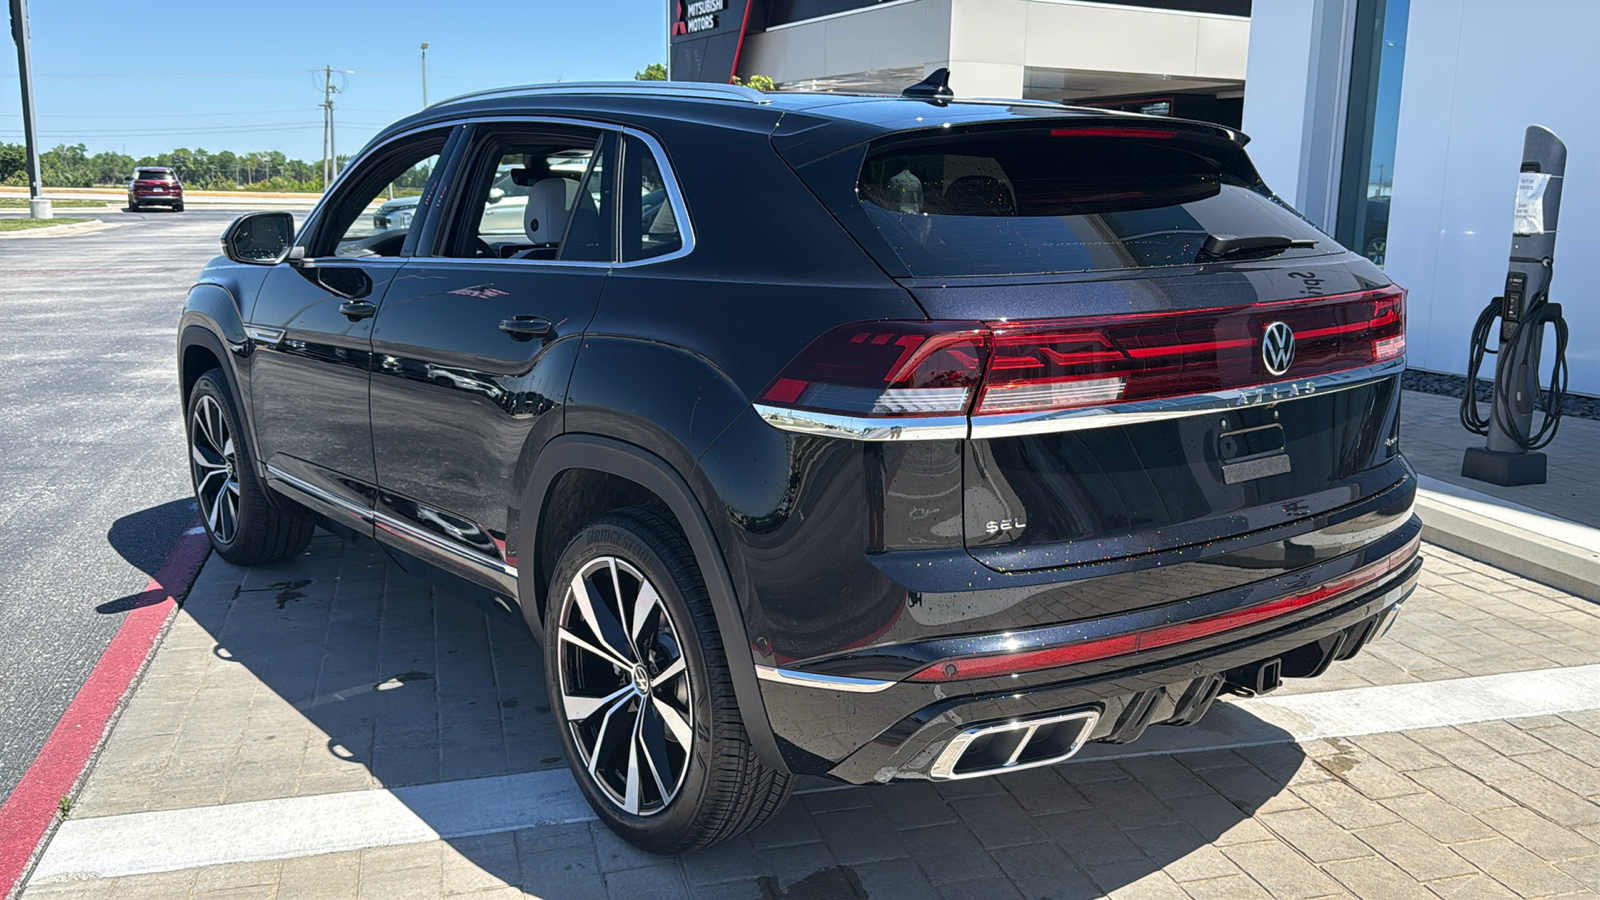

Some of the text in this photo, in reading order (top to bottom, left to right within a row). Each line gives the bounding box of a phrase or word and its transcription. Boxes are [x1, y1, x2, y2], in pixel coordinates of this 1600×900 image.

[687, 0, 723, 18] MITSUBISHI
[687, 14, 714, 34] MOTORS
[1235, 381, 1316, 406] ATLAS
[986, 517, 1026, 534] SEL
